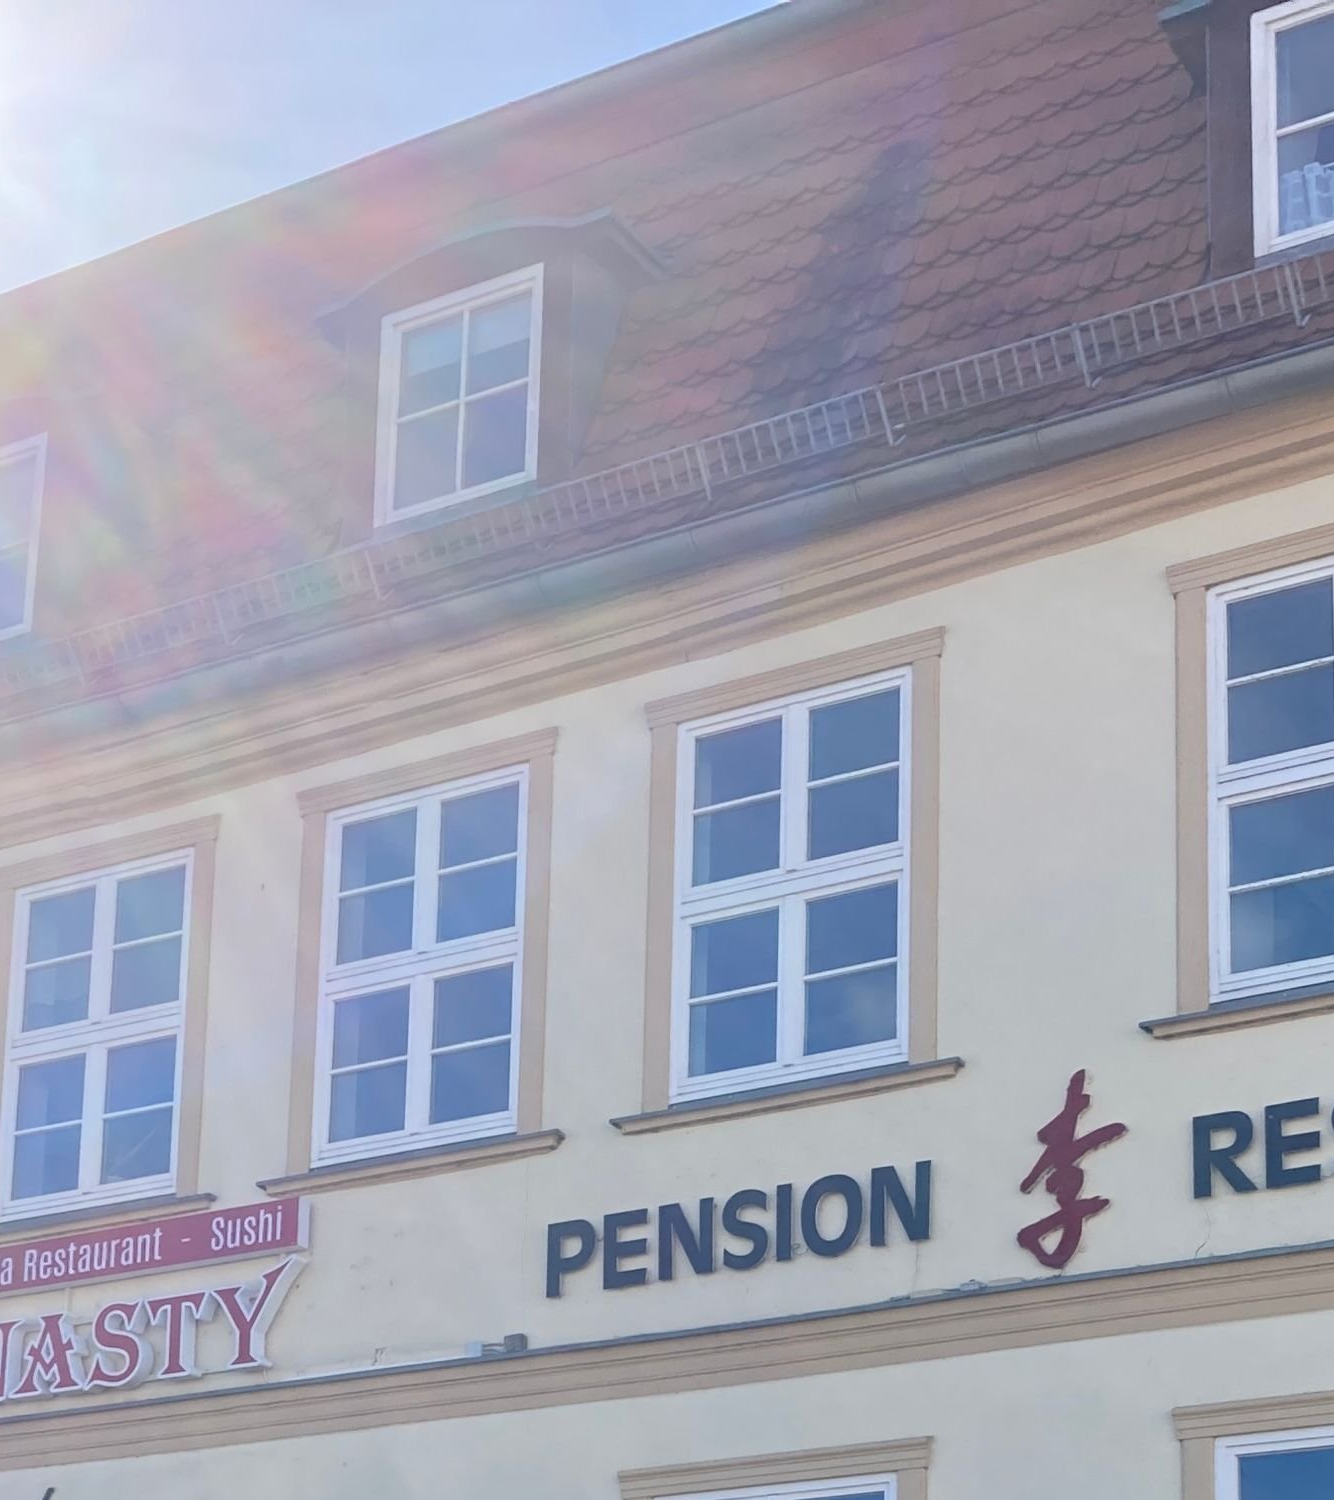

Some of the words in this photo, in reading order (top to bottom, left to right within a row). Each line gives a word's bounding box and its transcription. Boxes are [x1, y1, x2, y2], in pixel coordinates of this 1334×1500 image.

[23, 1227, 163, 1282] Restaurant
[210, 1206, 284, 1252] Sushi
[546, 1159, 931, 1298] PENSION
